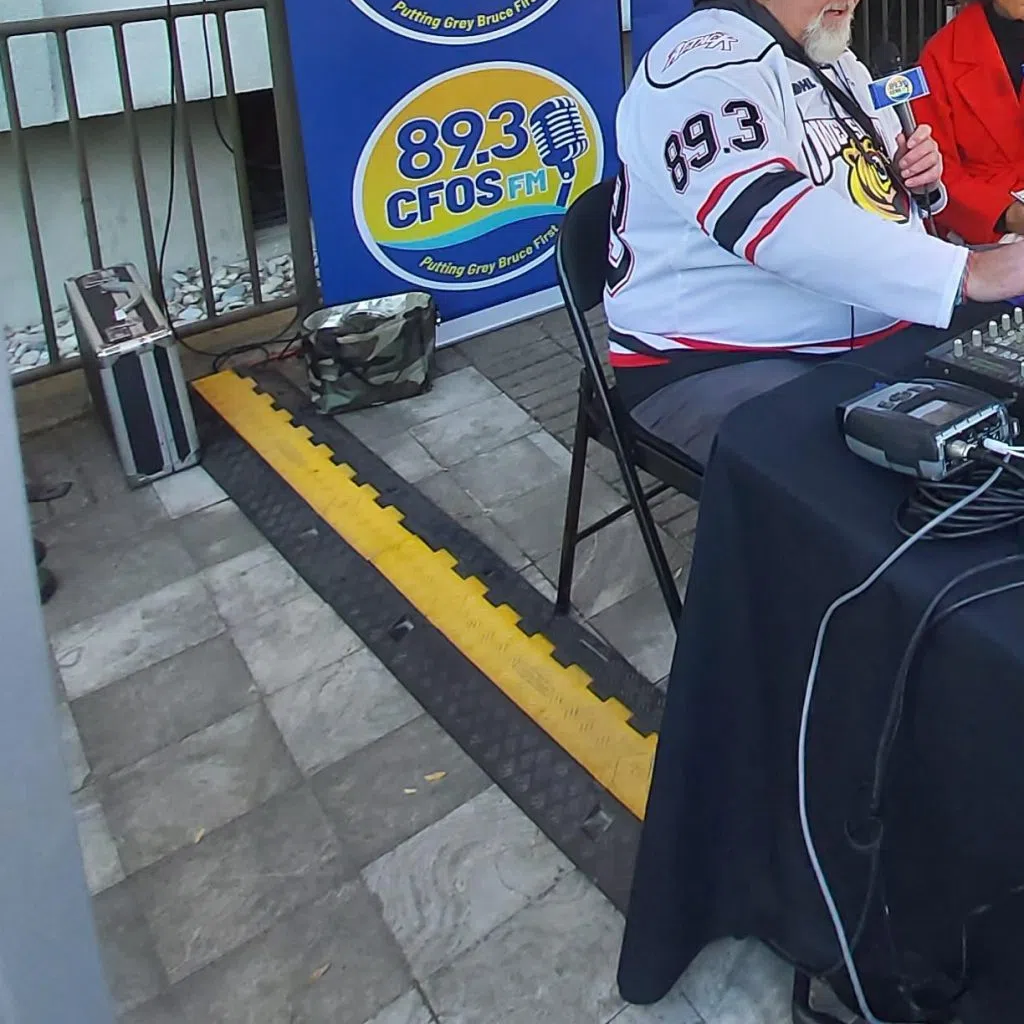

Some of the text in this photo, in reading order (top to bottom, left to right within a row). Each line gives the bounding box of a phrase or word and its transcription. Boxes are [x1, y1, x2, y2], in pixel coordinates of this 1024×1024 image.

[392, 0, 442, 30] Putting
[443, 17, 475, 32] Grey
[476, 7, 514, 27] Bruce
[396, 100, 529, 180] 89.3
[664, 99, 768, 194] 89.3
[385, 169, 547, 230] CFOS FM
[419, 224, 559, 278] Putting Grey Bruce First
